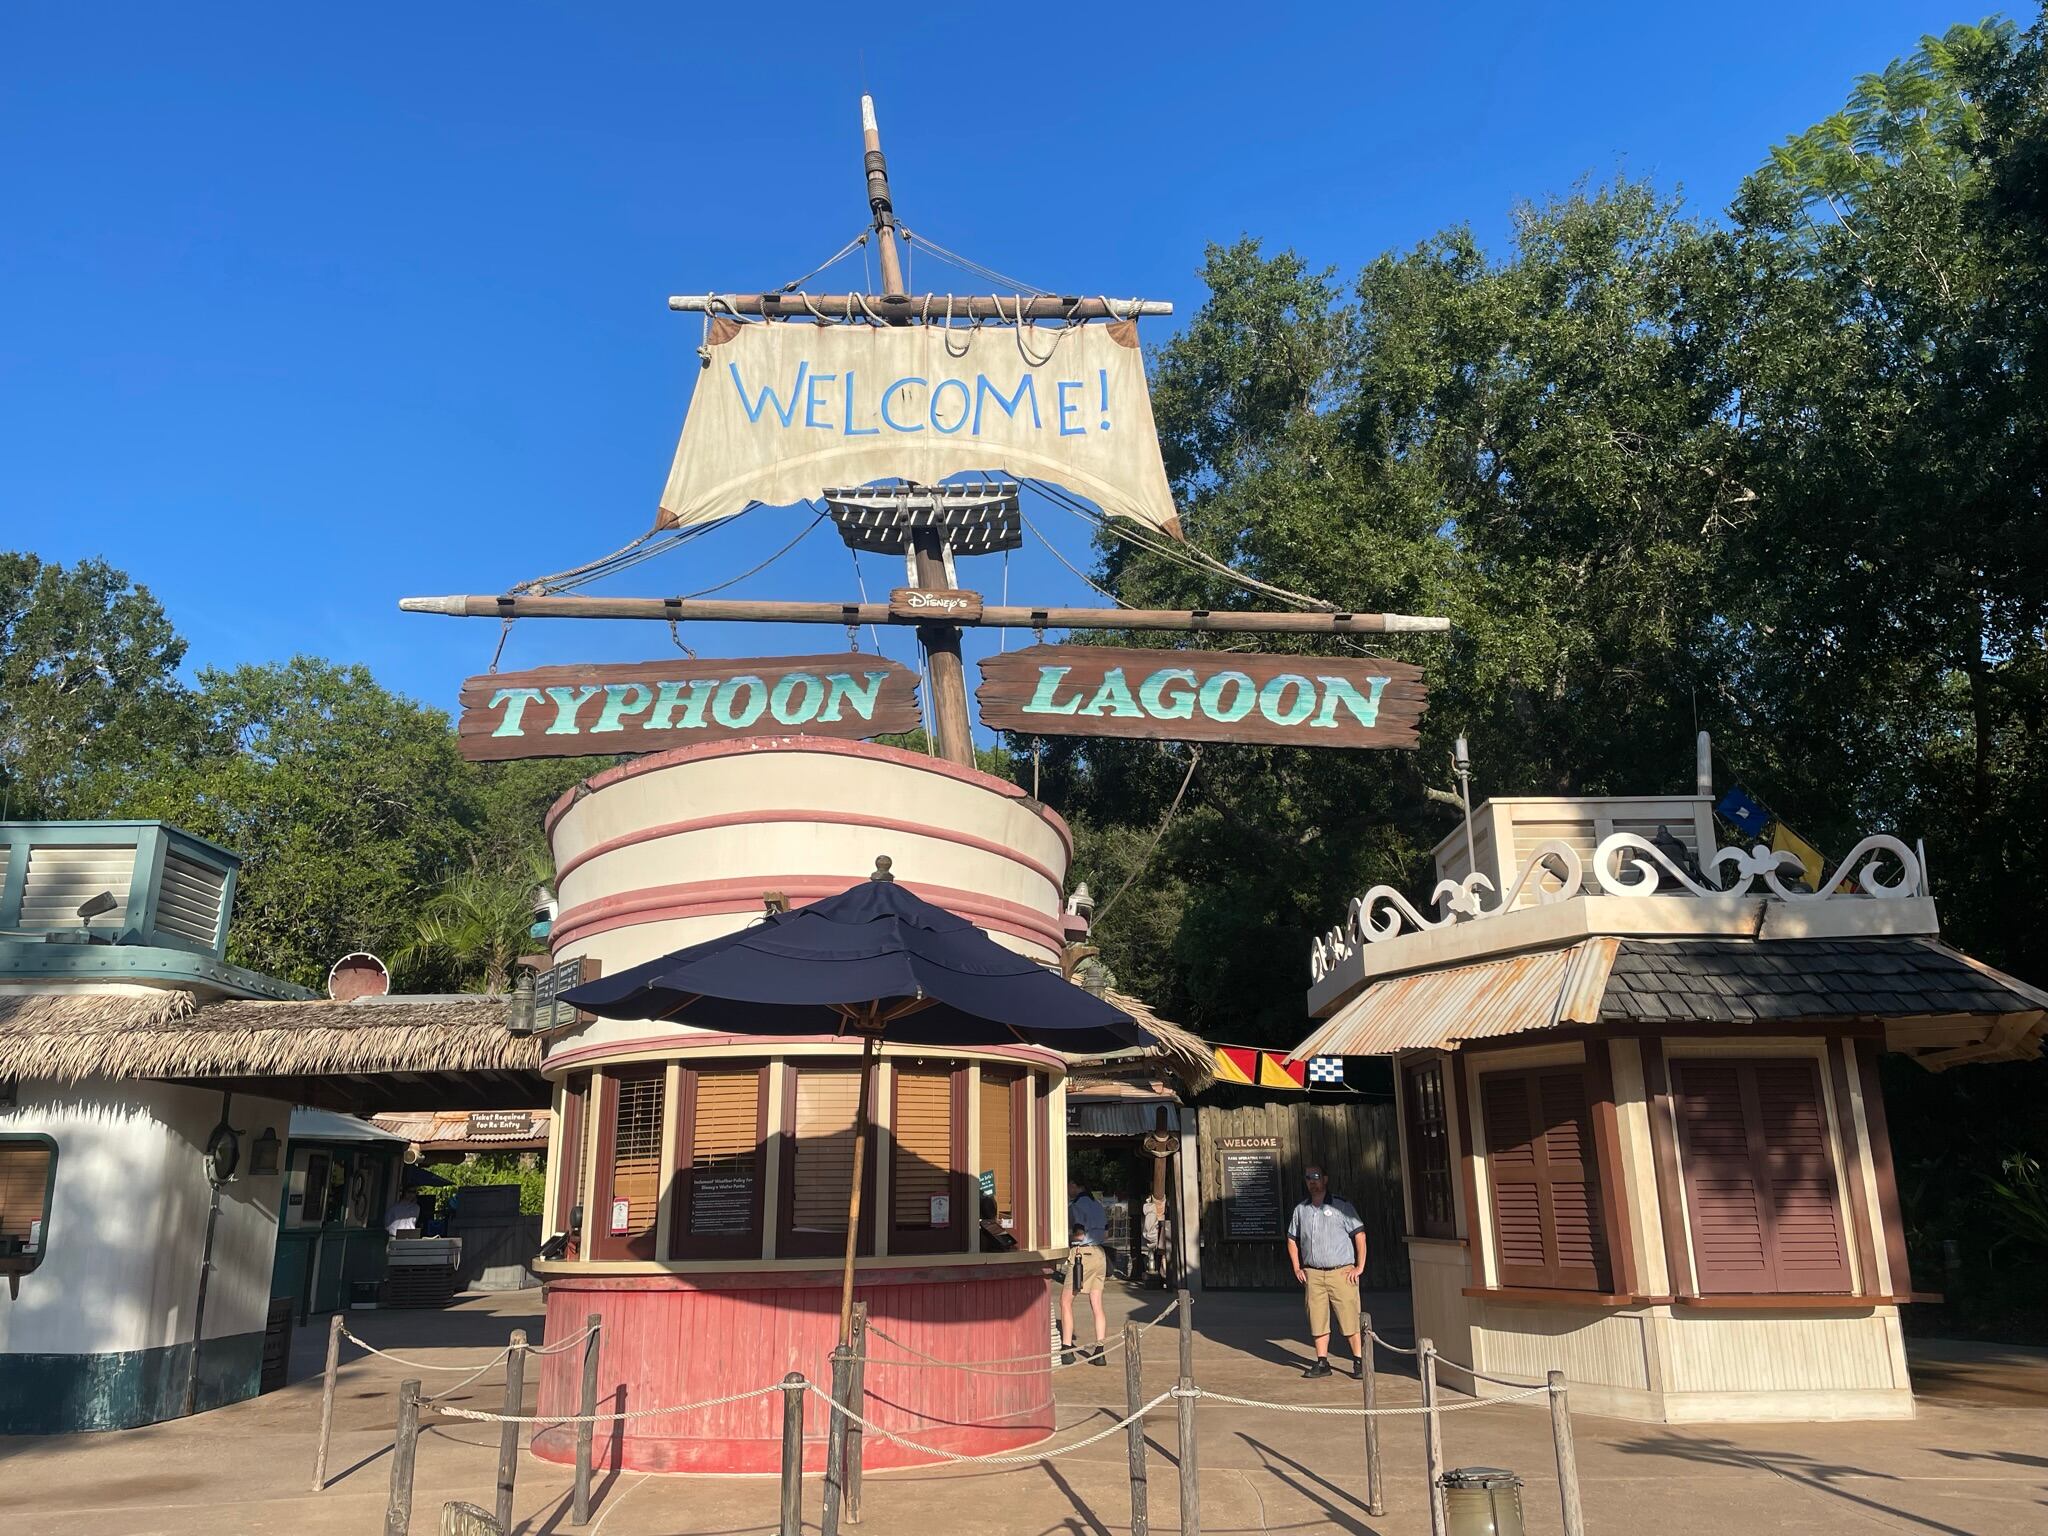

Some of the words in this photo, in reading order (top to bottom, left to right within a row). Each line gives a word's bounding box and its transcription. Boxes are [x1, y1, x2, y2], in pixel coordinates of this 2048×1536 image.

[729, 360, 1110, 437] WELCOME!
[488, 671, 890, 738] TYPHOON
[1021, 666, 1391, 729] LAGOON
[472, 1113, 494, 1121] Ticket
[494, 1113, 526, 1122] Required
[1223, 1138, 1278, 1148] WELCOME
